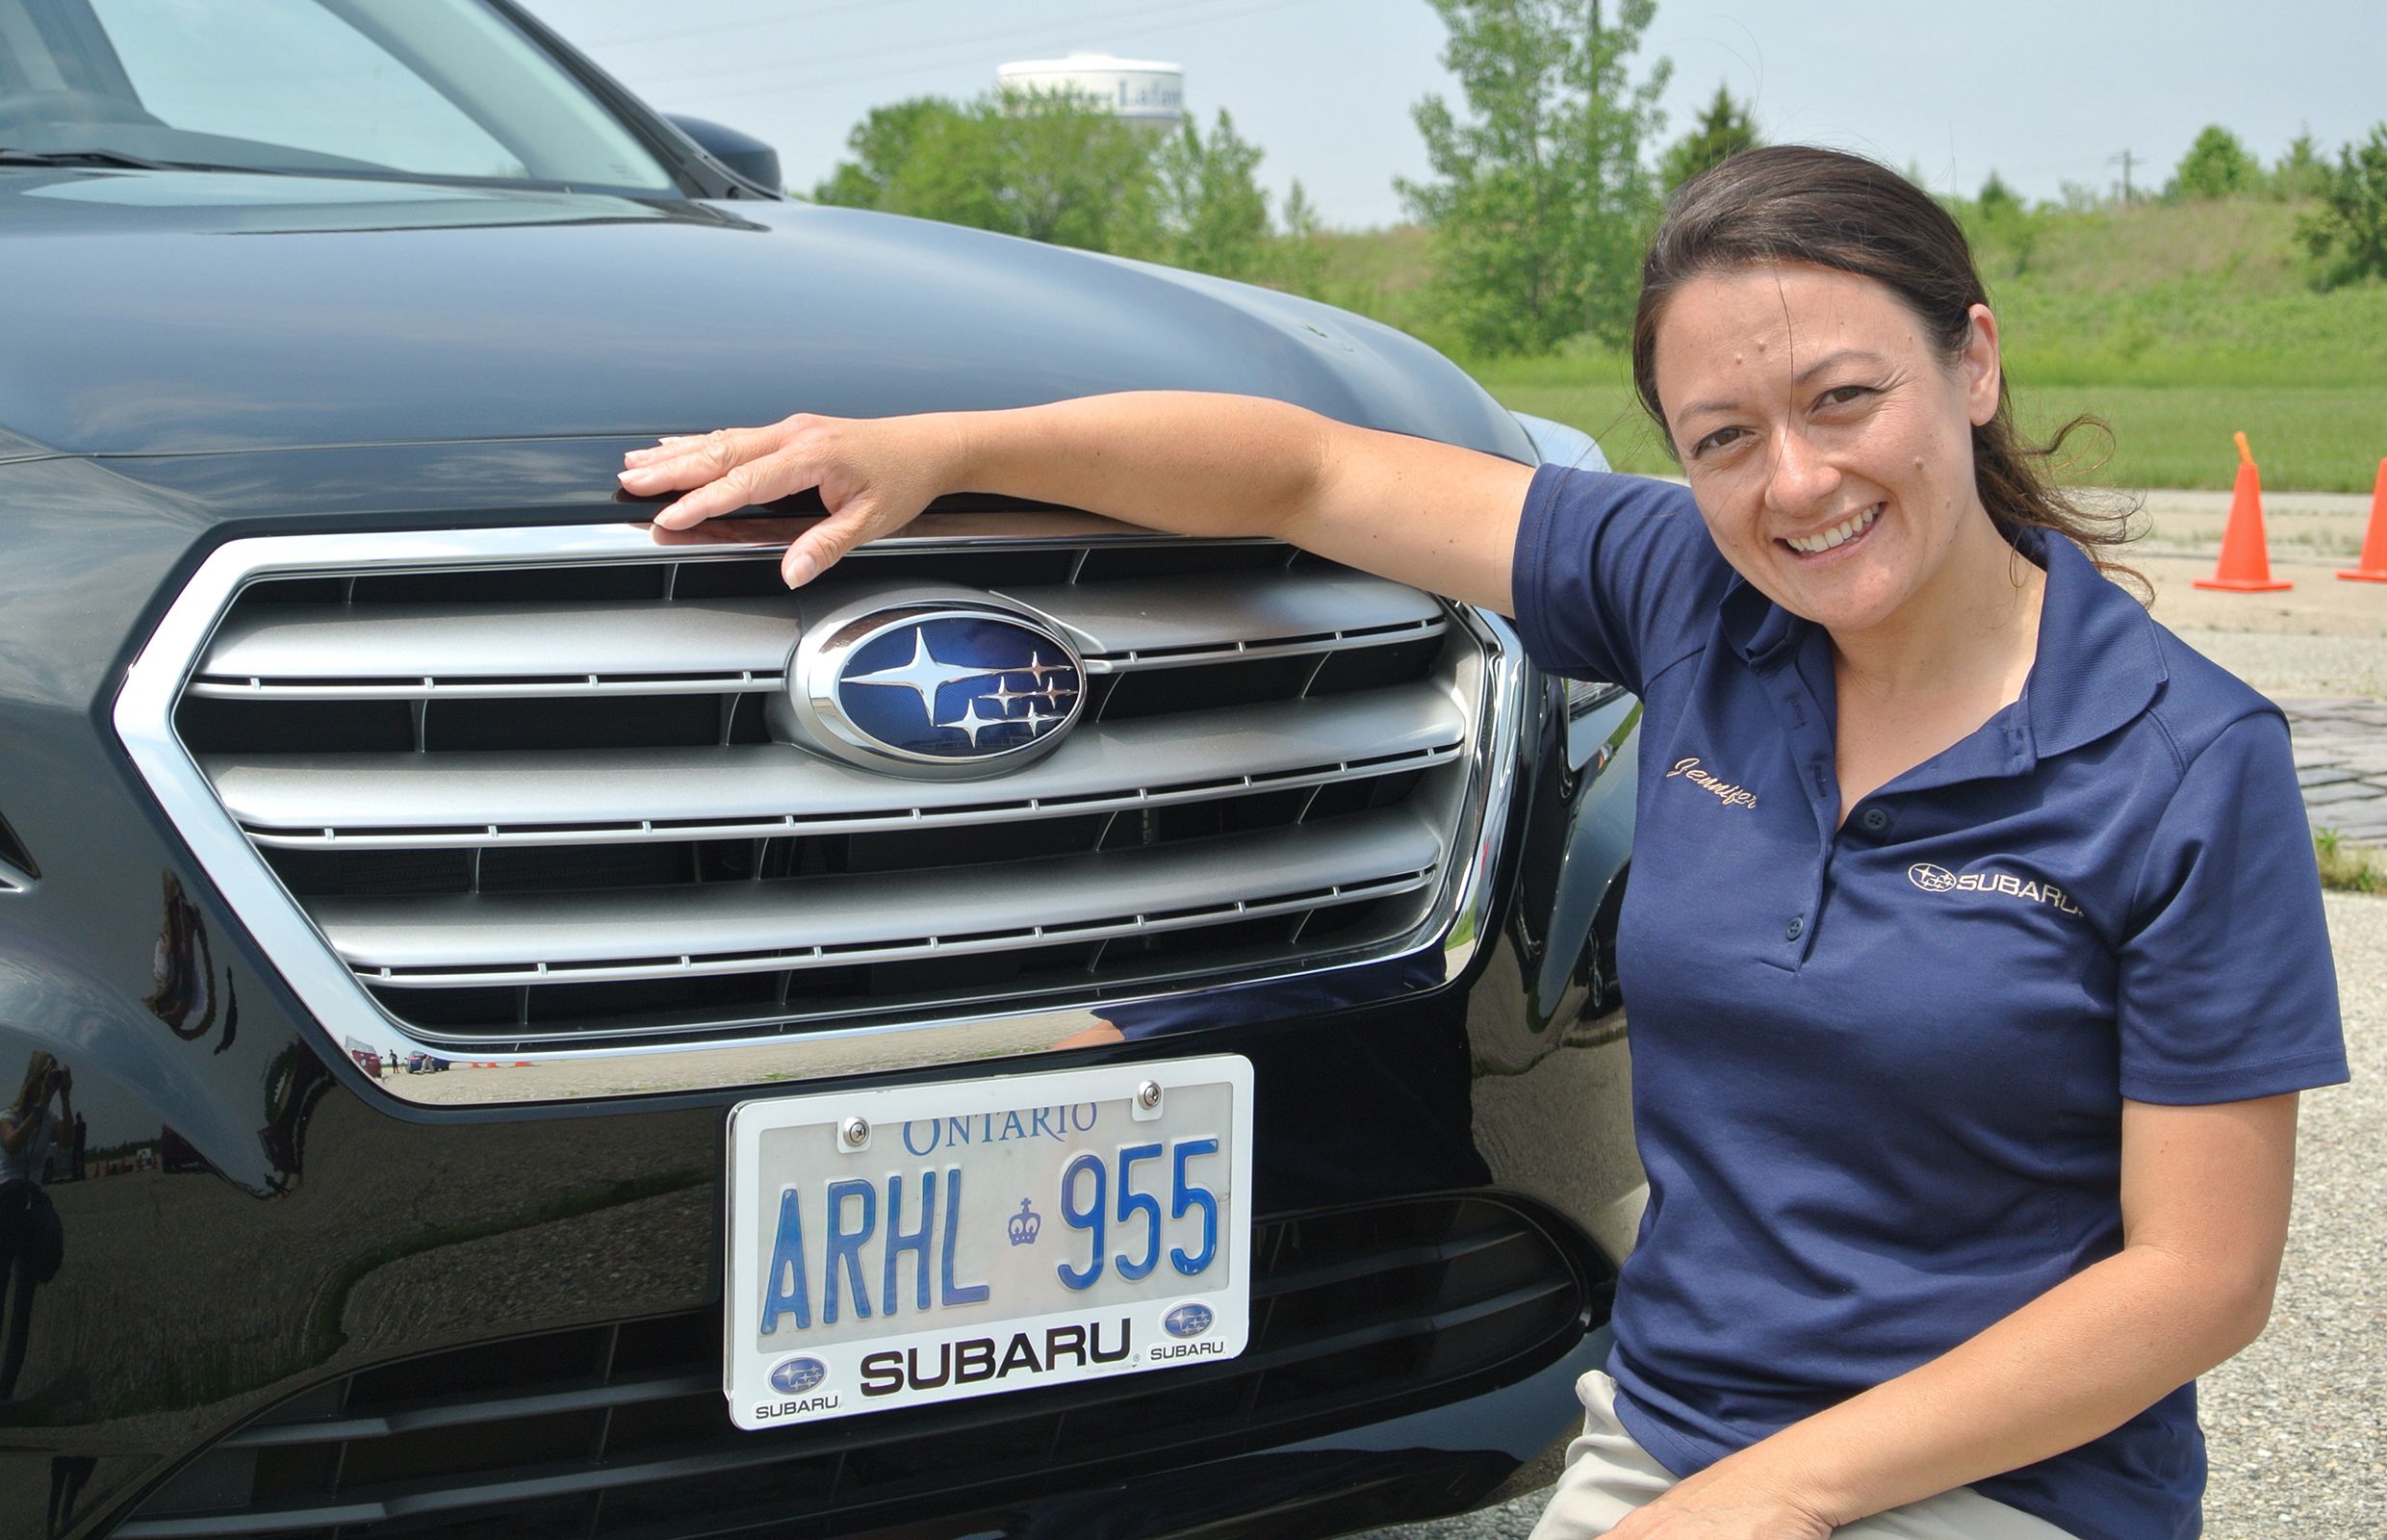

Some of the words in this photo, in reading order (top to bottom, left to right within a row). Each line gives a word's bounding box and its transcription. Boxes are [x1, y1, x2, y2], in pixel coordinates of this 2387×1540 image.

[1665, 757, 1757, 809] Jennifer
[1956, 875, 2079, 914] SUBARU
[903, 1102, 1097, 1156] ONTARIO
[759, 1168, 990, 1335] ARHL
[1057, 1139, 1219, 1291] 955
[860, 1317, 1132, 1398] SUBARU
[1150, 1341, 1223, 1361] SUBARU
[756, 1395, 839, 1421] SUBARU
